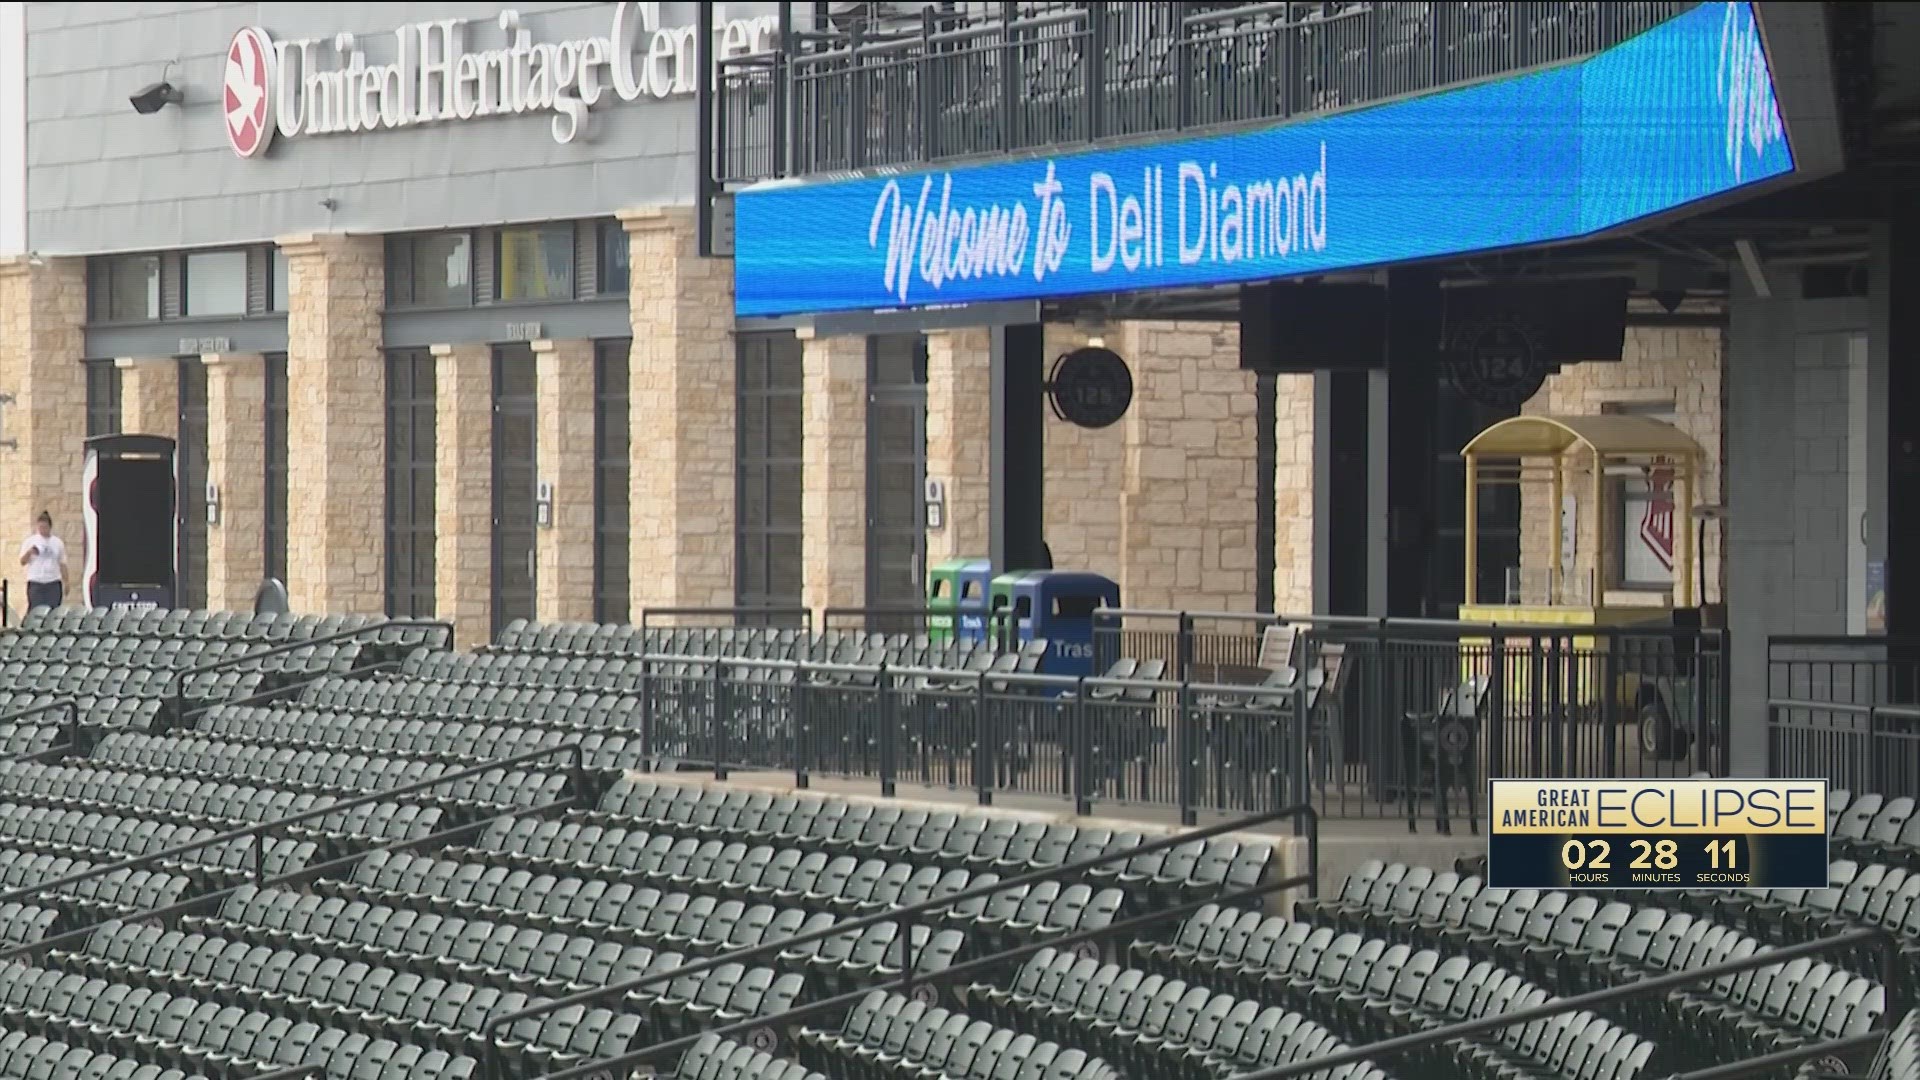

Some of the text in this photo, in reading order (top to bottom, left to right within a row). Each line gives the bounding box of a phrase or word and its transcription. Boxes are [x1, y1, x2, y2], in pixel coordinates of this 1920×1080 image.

[273, 2, 779, 144] United Heritage Cener
[869, 139, 1327, 304] Welcome to Dell Diamond
[1479, 356, 1524, 380] 124
[1053, 639, 1094, 659] Tras
